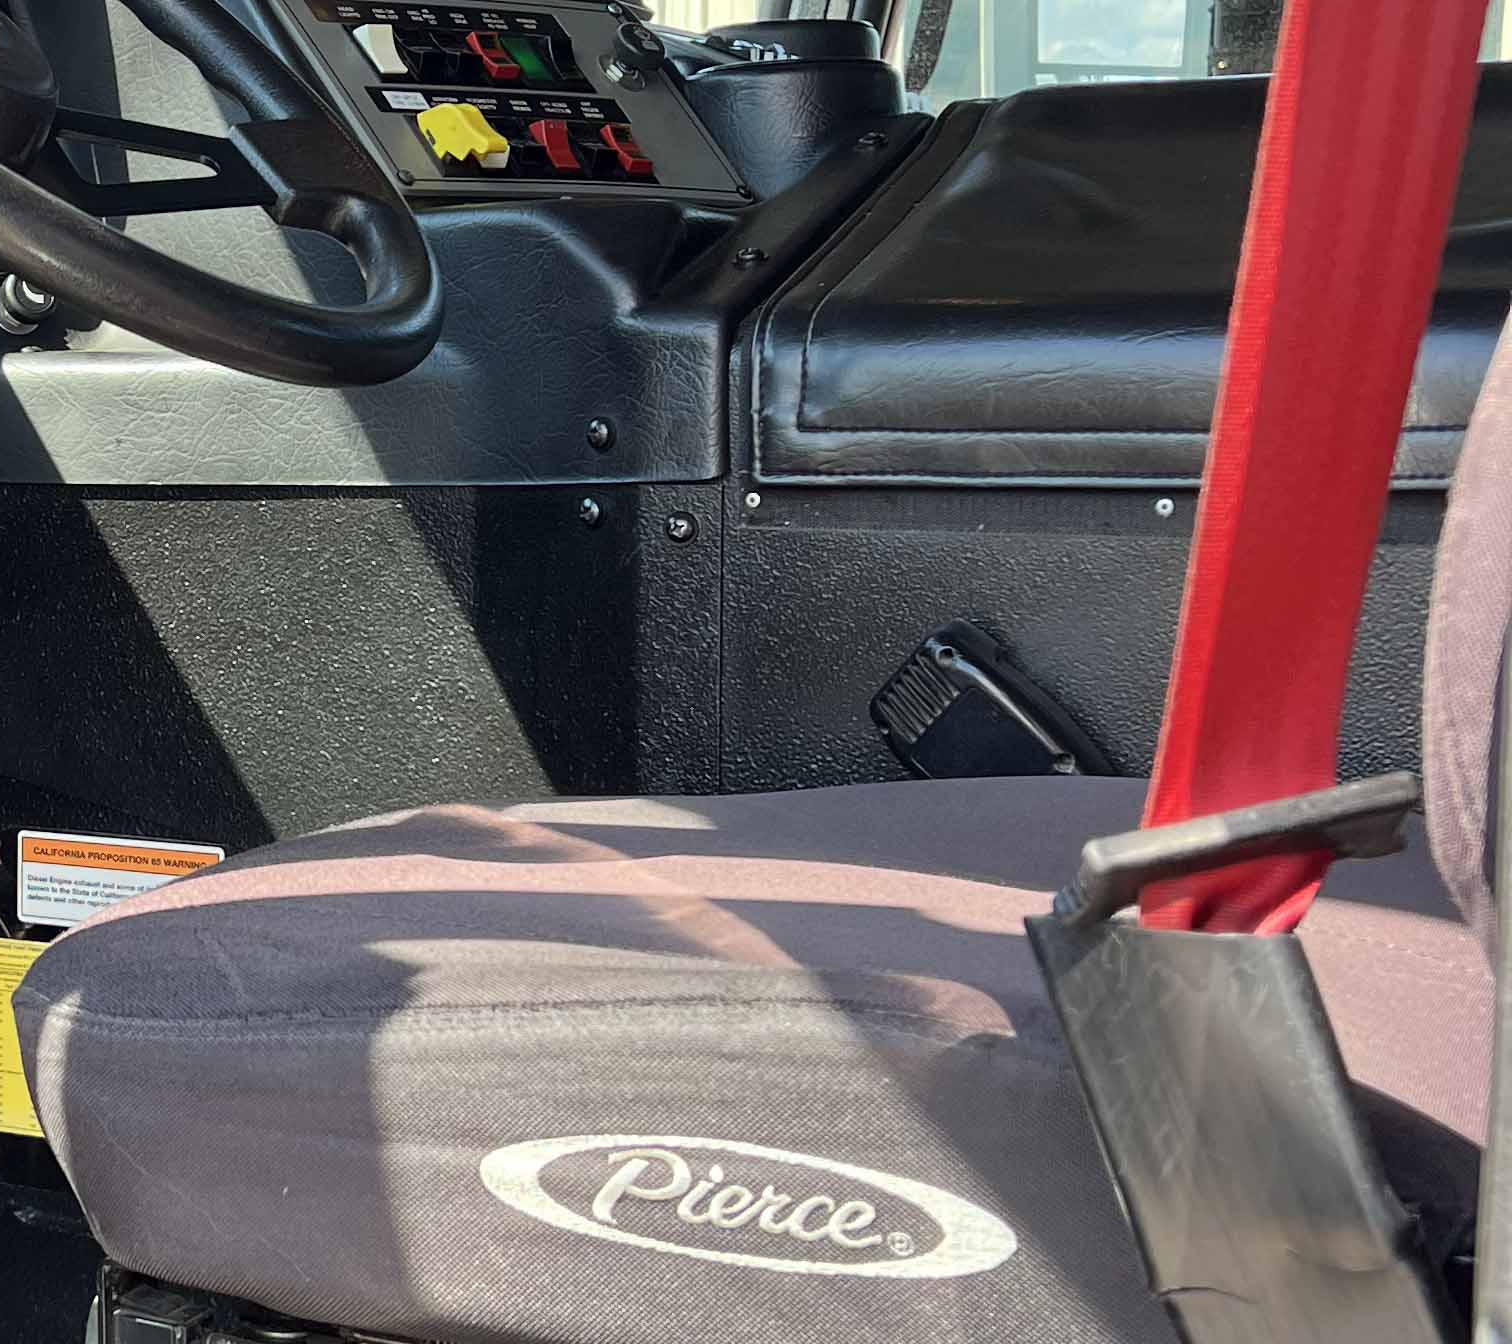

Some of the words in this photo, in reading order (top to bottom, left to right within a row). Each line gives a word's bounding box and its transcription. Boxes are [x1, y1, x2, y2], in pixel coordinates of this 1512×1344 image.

[33, 846, 85, 859] CALIFORNIA
[88, 851, 148, 865] PROPOSITION
[591, 1148, 883, 1249] Pierce
